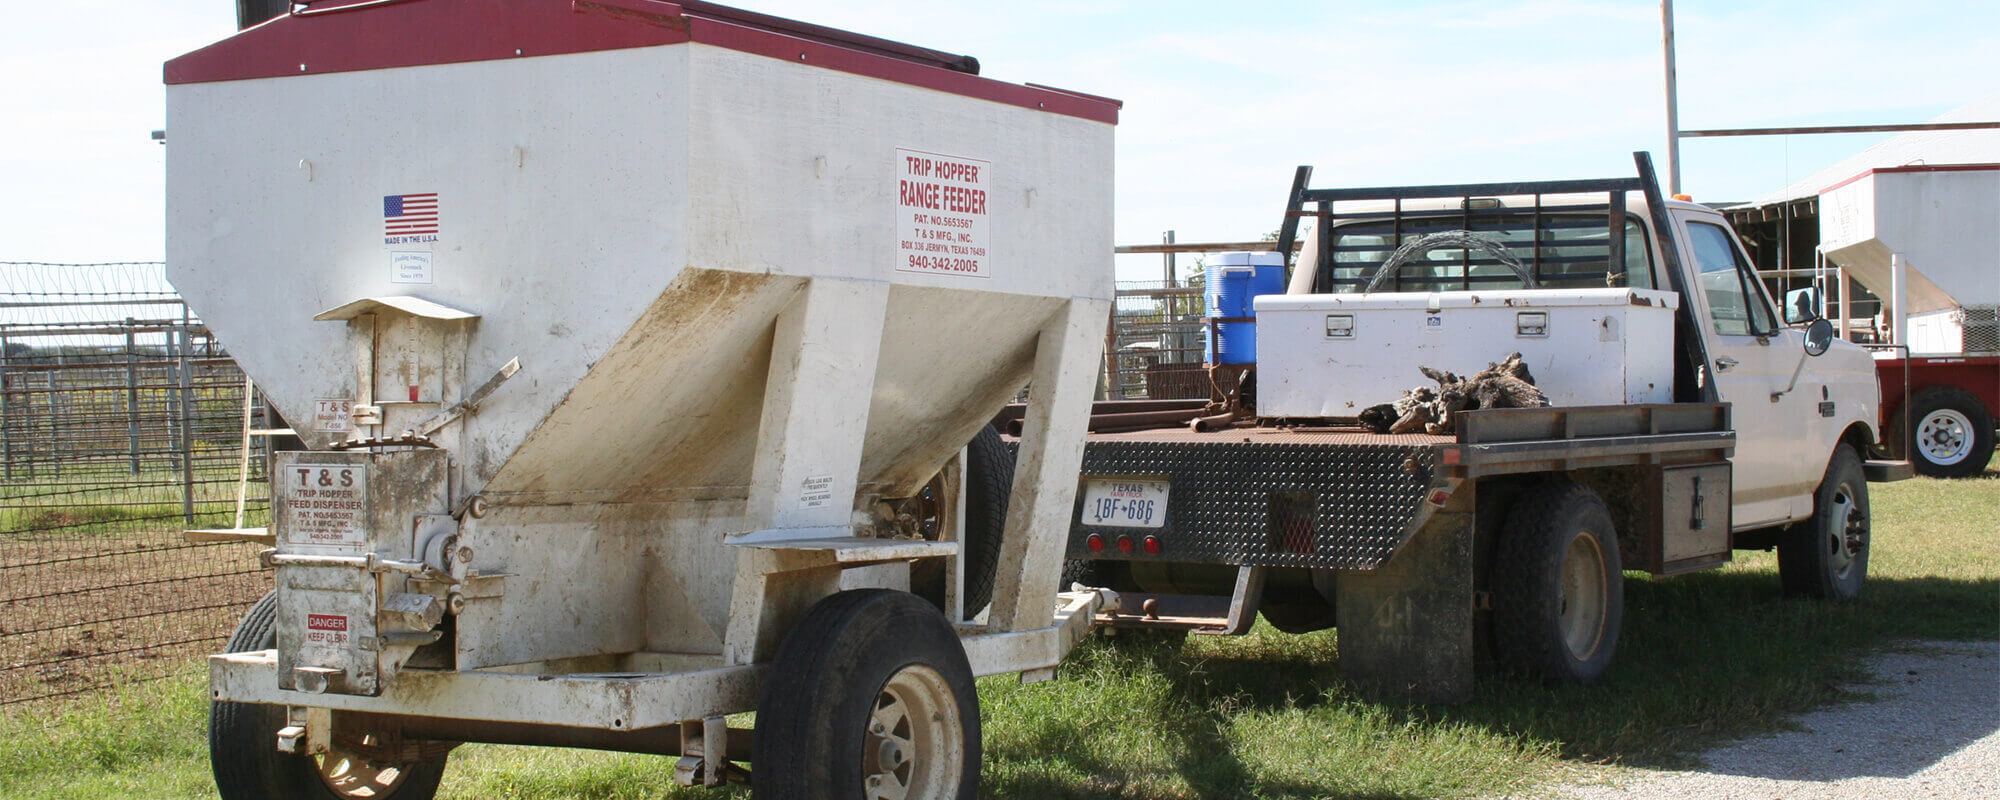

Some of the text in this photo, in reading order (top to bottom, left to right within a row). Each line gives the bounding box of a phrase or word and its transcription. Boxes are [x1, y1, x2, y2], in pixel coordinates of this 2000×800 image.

[906, 156, 979, 184] TRIP HOPPER
[900, 179, 986, 215] RANGE FEEDER
[914, 213, 973, 229] PAT. NO.5653567
[914, 228, 973, 243] T & S MFG., INC.
[901, 240, 913, 249] BOX
[951, 245, 969, 255] TEXAS
[909, 254, 978, 273] 940-342-2005
[320, 401, 349, 412] T & S
[297, 468, 354, 487] T & S
[298, 489, 353, 499] TRIP HOPPER
[1112, 483, 1144, 492] TEXAS
[289, 500, 363, 510] FEED DISPENSER
[1128, 499, 1154, 520] 686
[309, 617, 345, 628] DANGER
[308, 632, 348, 643] KEEP CLEAR
